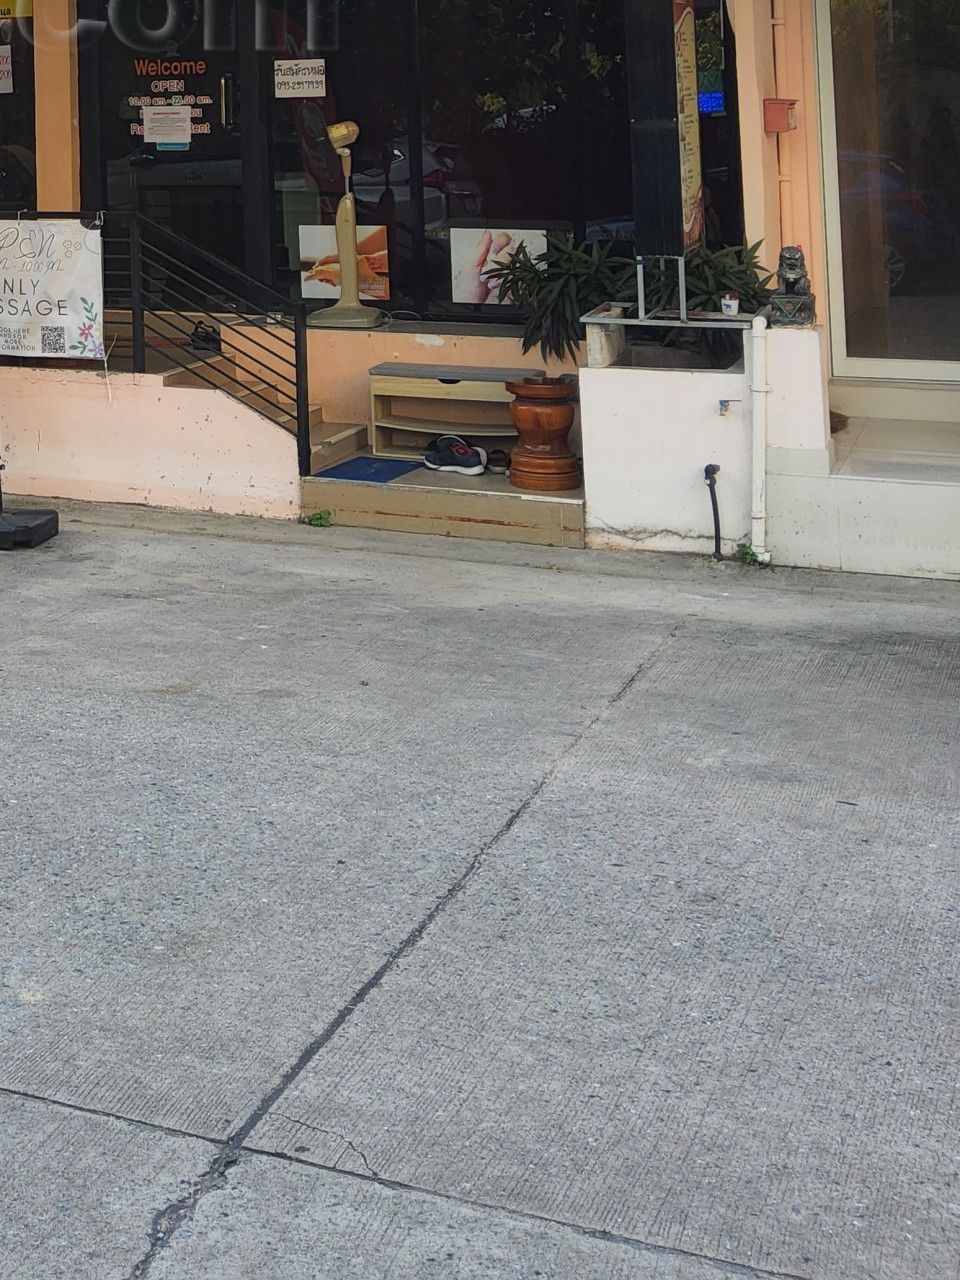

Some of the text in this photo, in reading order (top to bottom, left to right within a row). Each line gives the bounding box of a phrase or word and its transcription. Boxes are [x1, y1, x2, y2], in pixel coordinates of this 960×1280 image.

[134, 58, 207, 76] Welcome
[151, 80, 185, 93] OPEN
[4, 338, 22, 346] MORE
